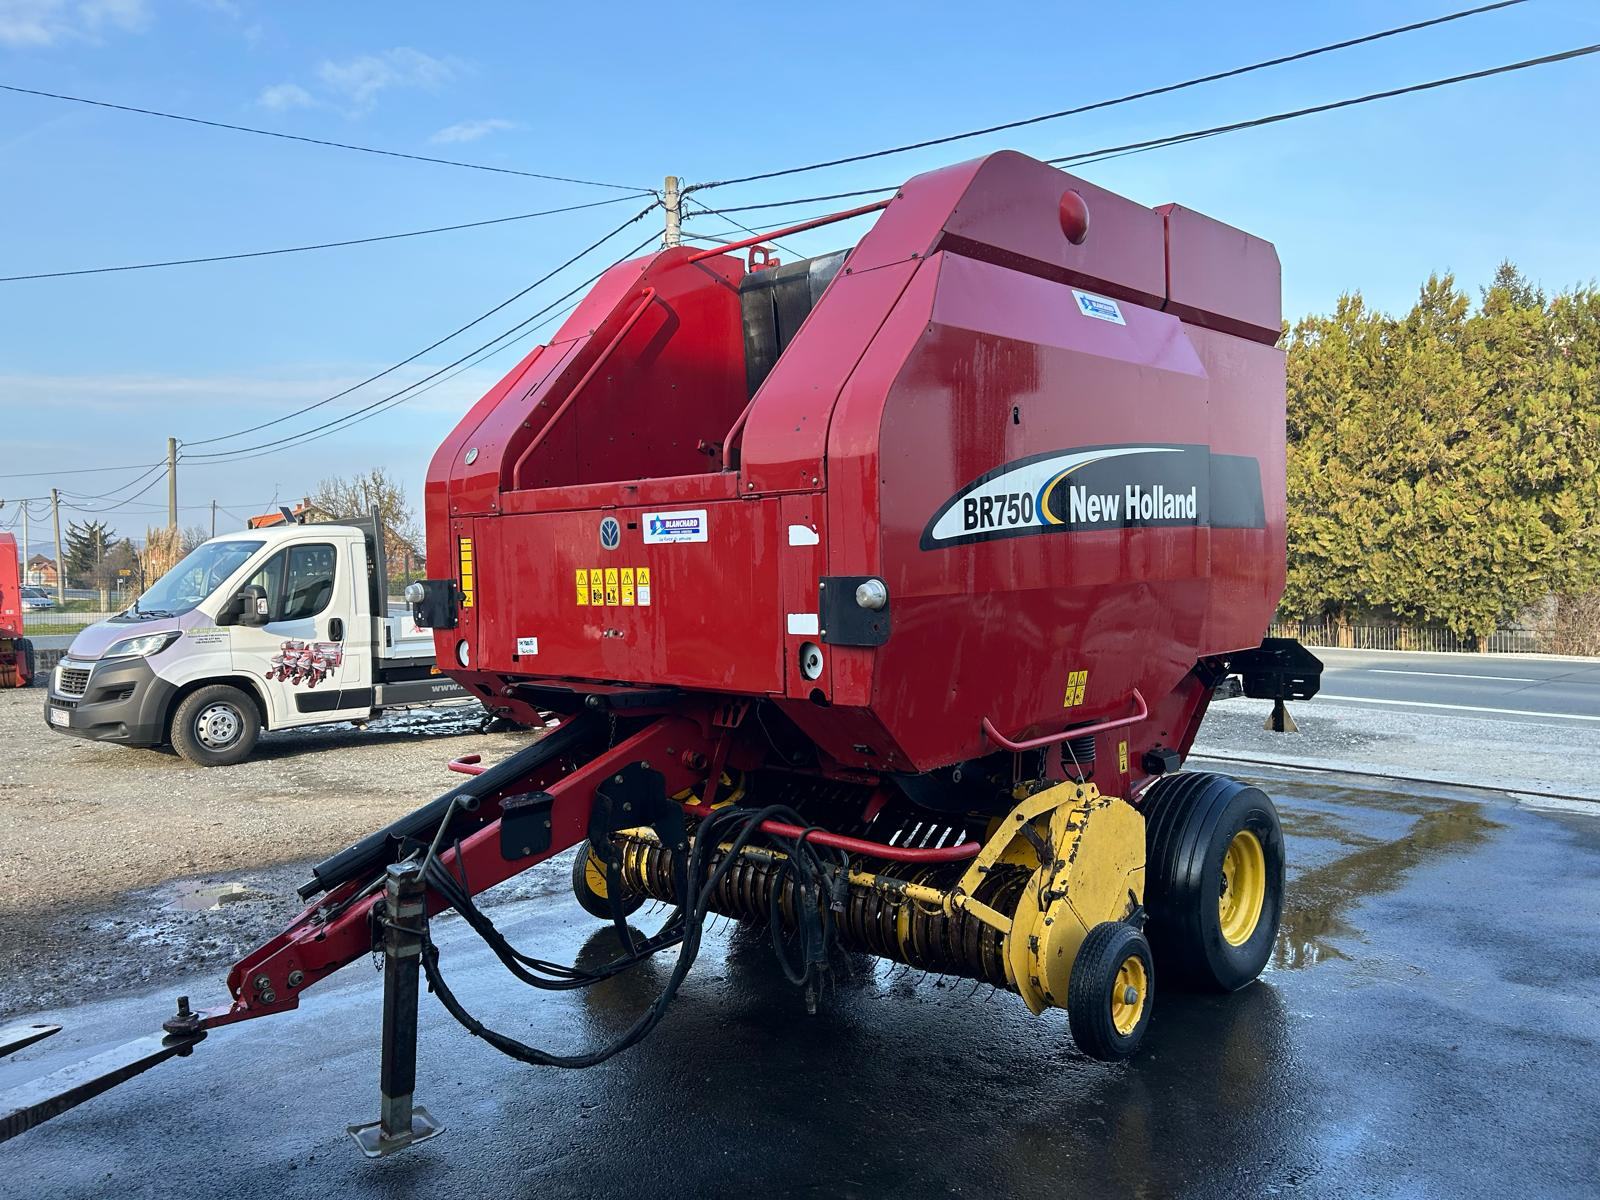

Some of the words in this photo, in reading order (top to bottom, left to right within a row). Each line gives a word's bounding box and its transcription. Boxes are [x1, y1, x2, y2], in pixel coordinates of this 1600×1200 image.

[963, 492, 1033, 531] BR750
[1069, 485, 1121, 523] New
[1125, 484, 1197, 520] Holland
[666, 519, 698, 528] BLANCHARD
